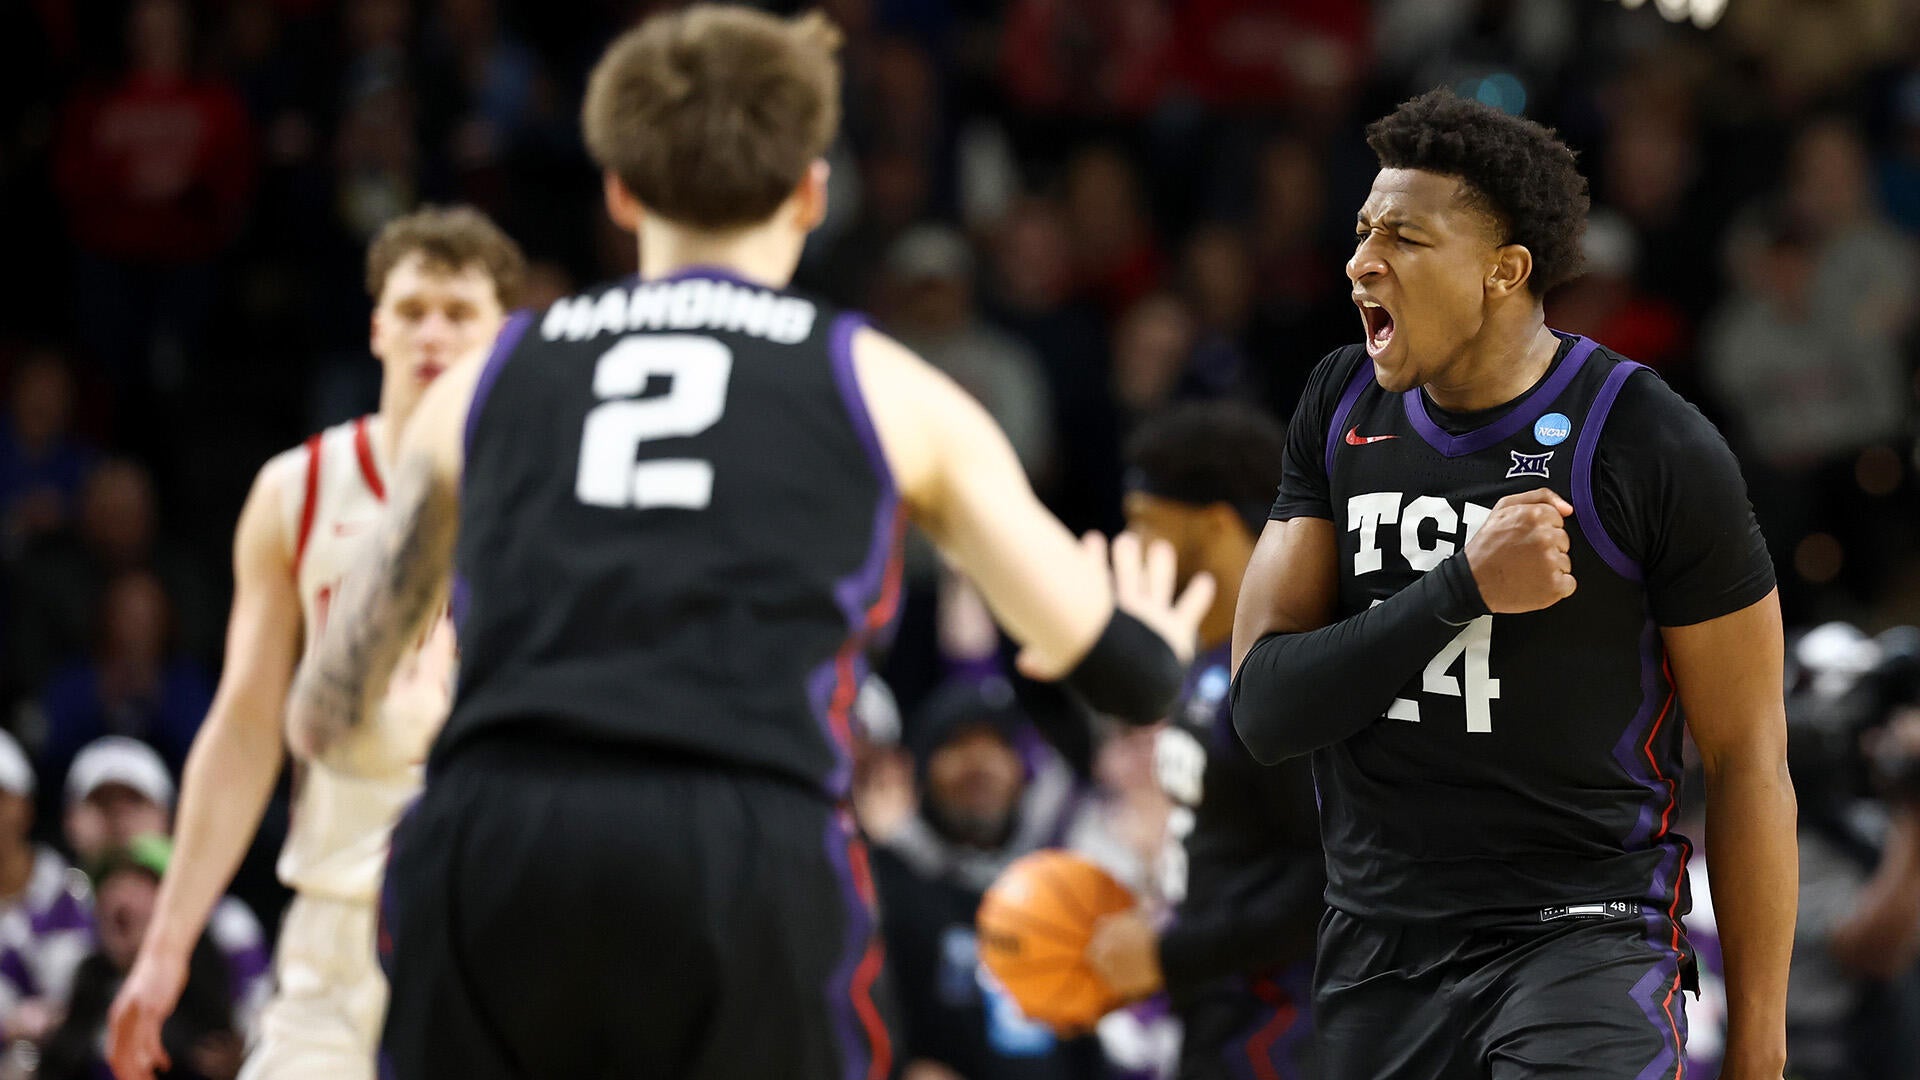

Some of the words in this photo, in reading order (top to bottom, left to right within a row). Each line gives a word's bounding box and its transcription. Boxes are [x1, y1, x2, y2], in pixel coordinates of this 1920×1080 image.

[540, 278, 817, 344] HARDING
[575, 332, 733, 510] 2
[1538, 427, 1567, 438] NCAA
[1506, 450, 1554, 478] XII
[1610, 901, 1626, 912] 48
